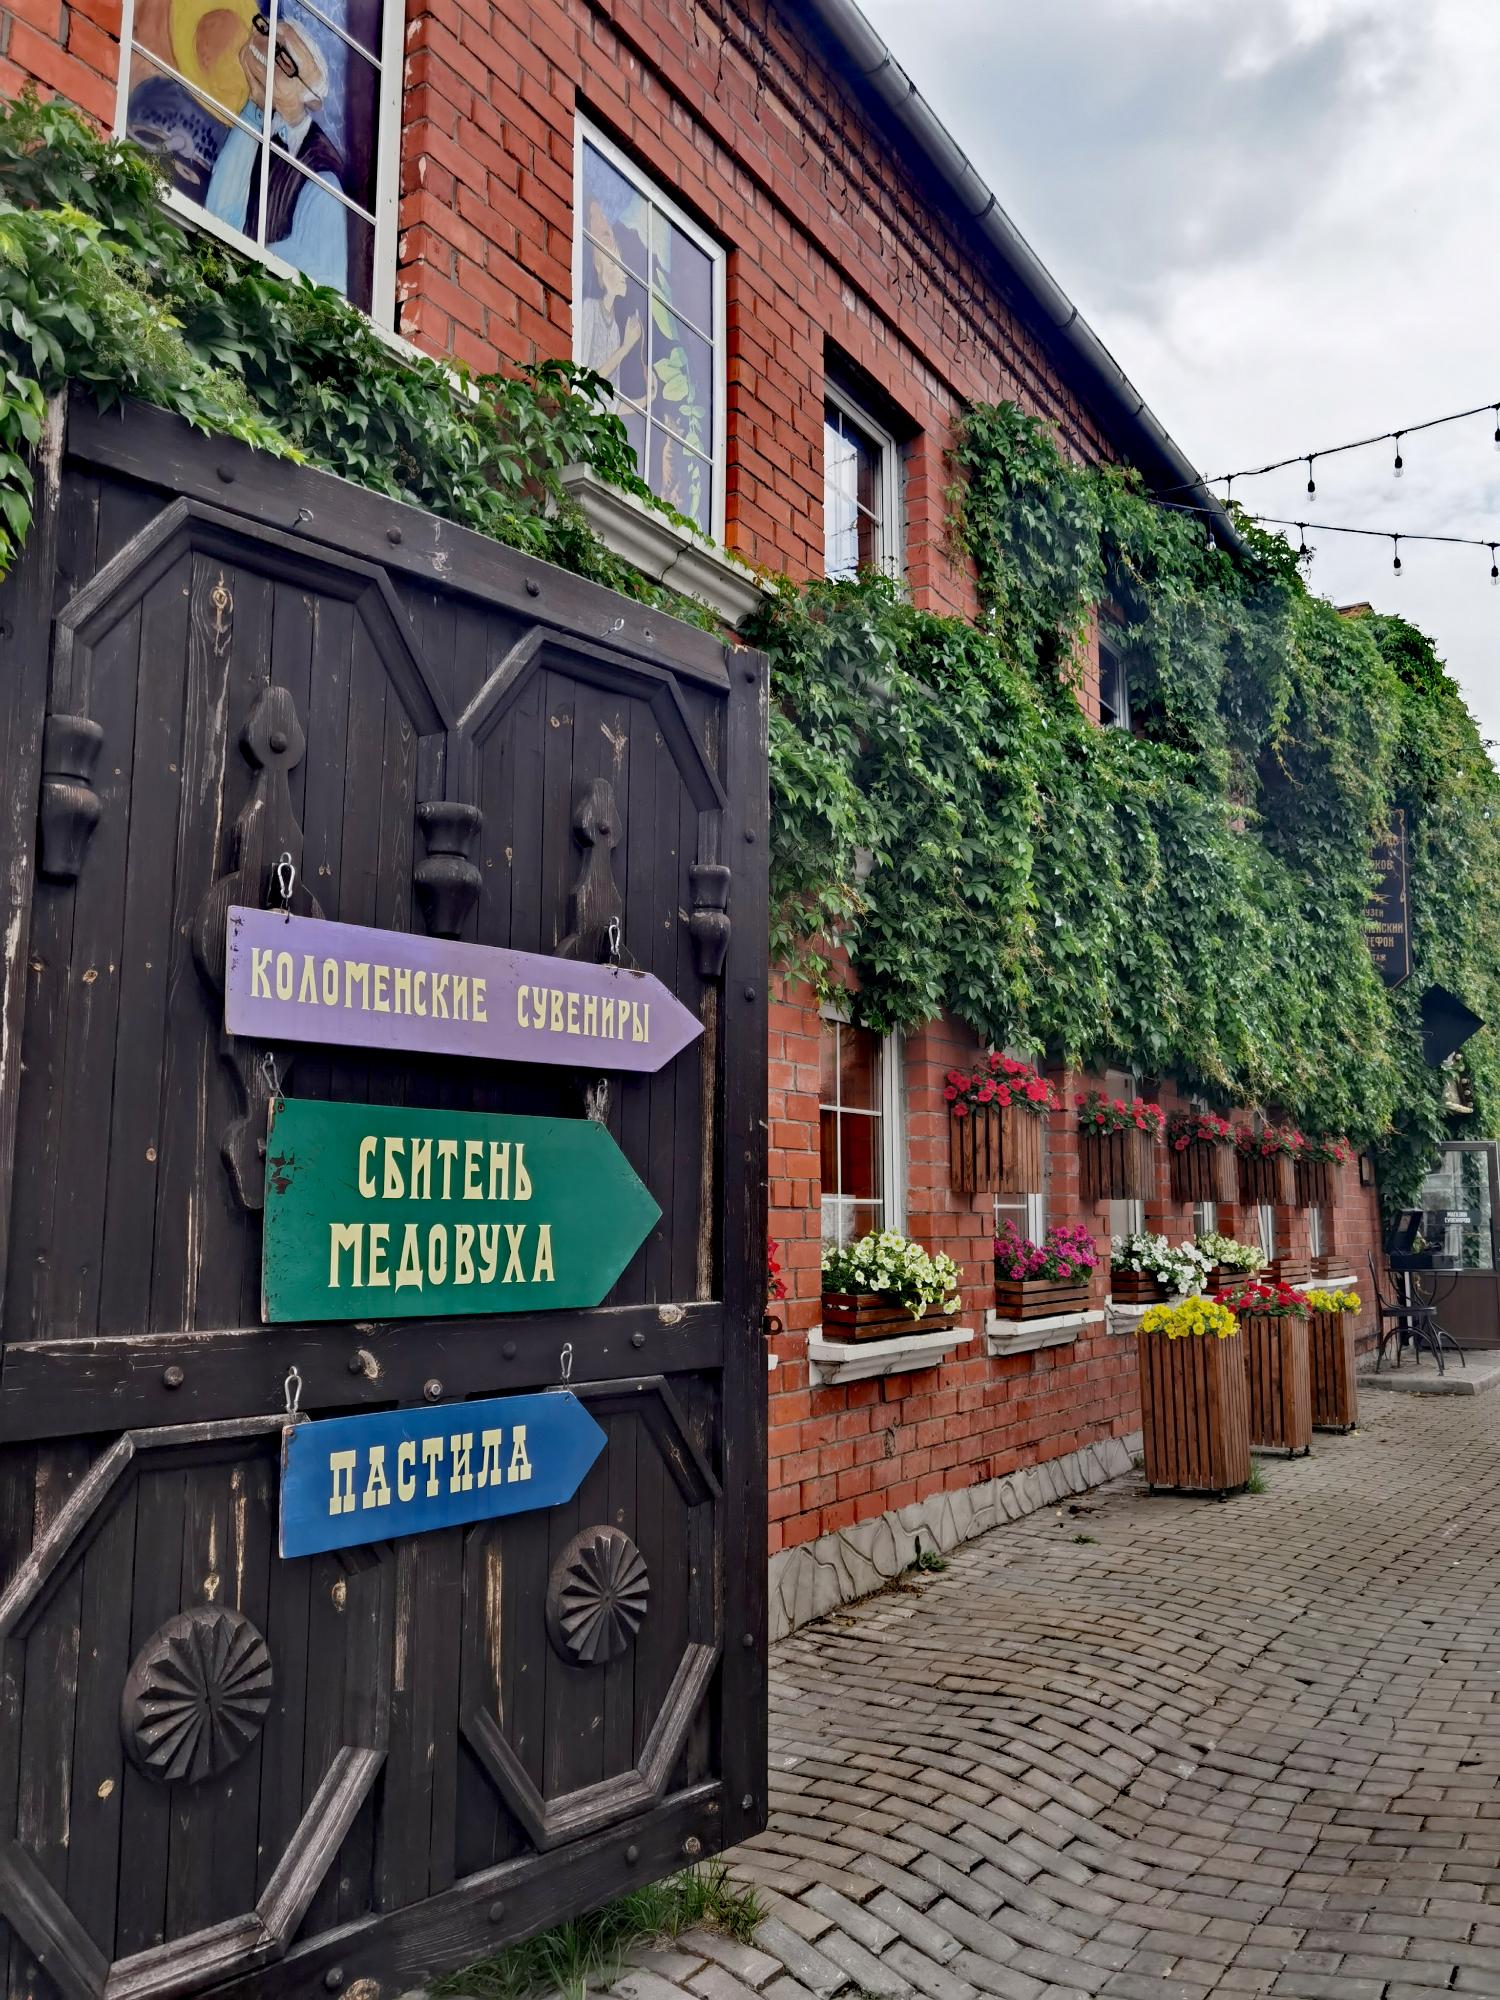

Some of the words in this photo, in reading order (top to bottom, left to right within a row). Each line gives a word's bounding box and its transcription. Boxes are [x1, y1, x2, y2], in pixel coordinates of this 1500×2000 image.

[250, 947, 489, 1023] КОЛОМЕНСКИЕ
[516, 985, 651, 1043] СУВЕНИРЫ
[358, 1135, 533, 1201] СБИТЕНЬ
[328, 1223, 556, 1294] МЕДОВУХА
[329, 1425, 532, 1516] ПАСТИЛА
